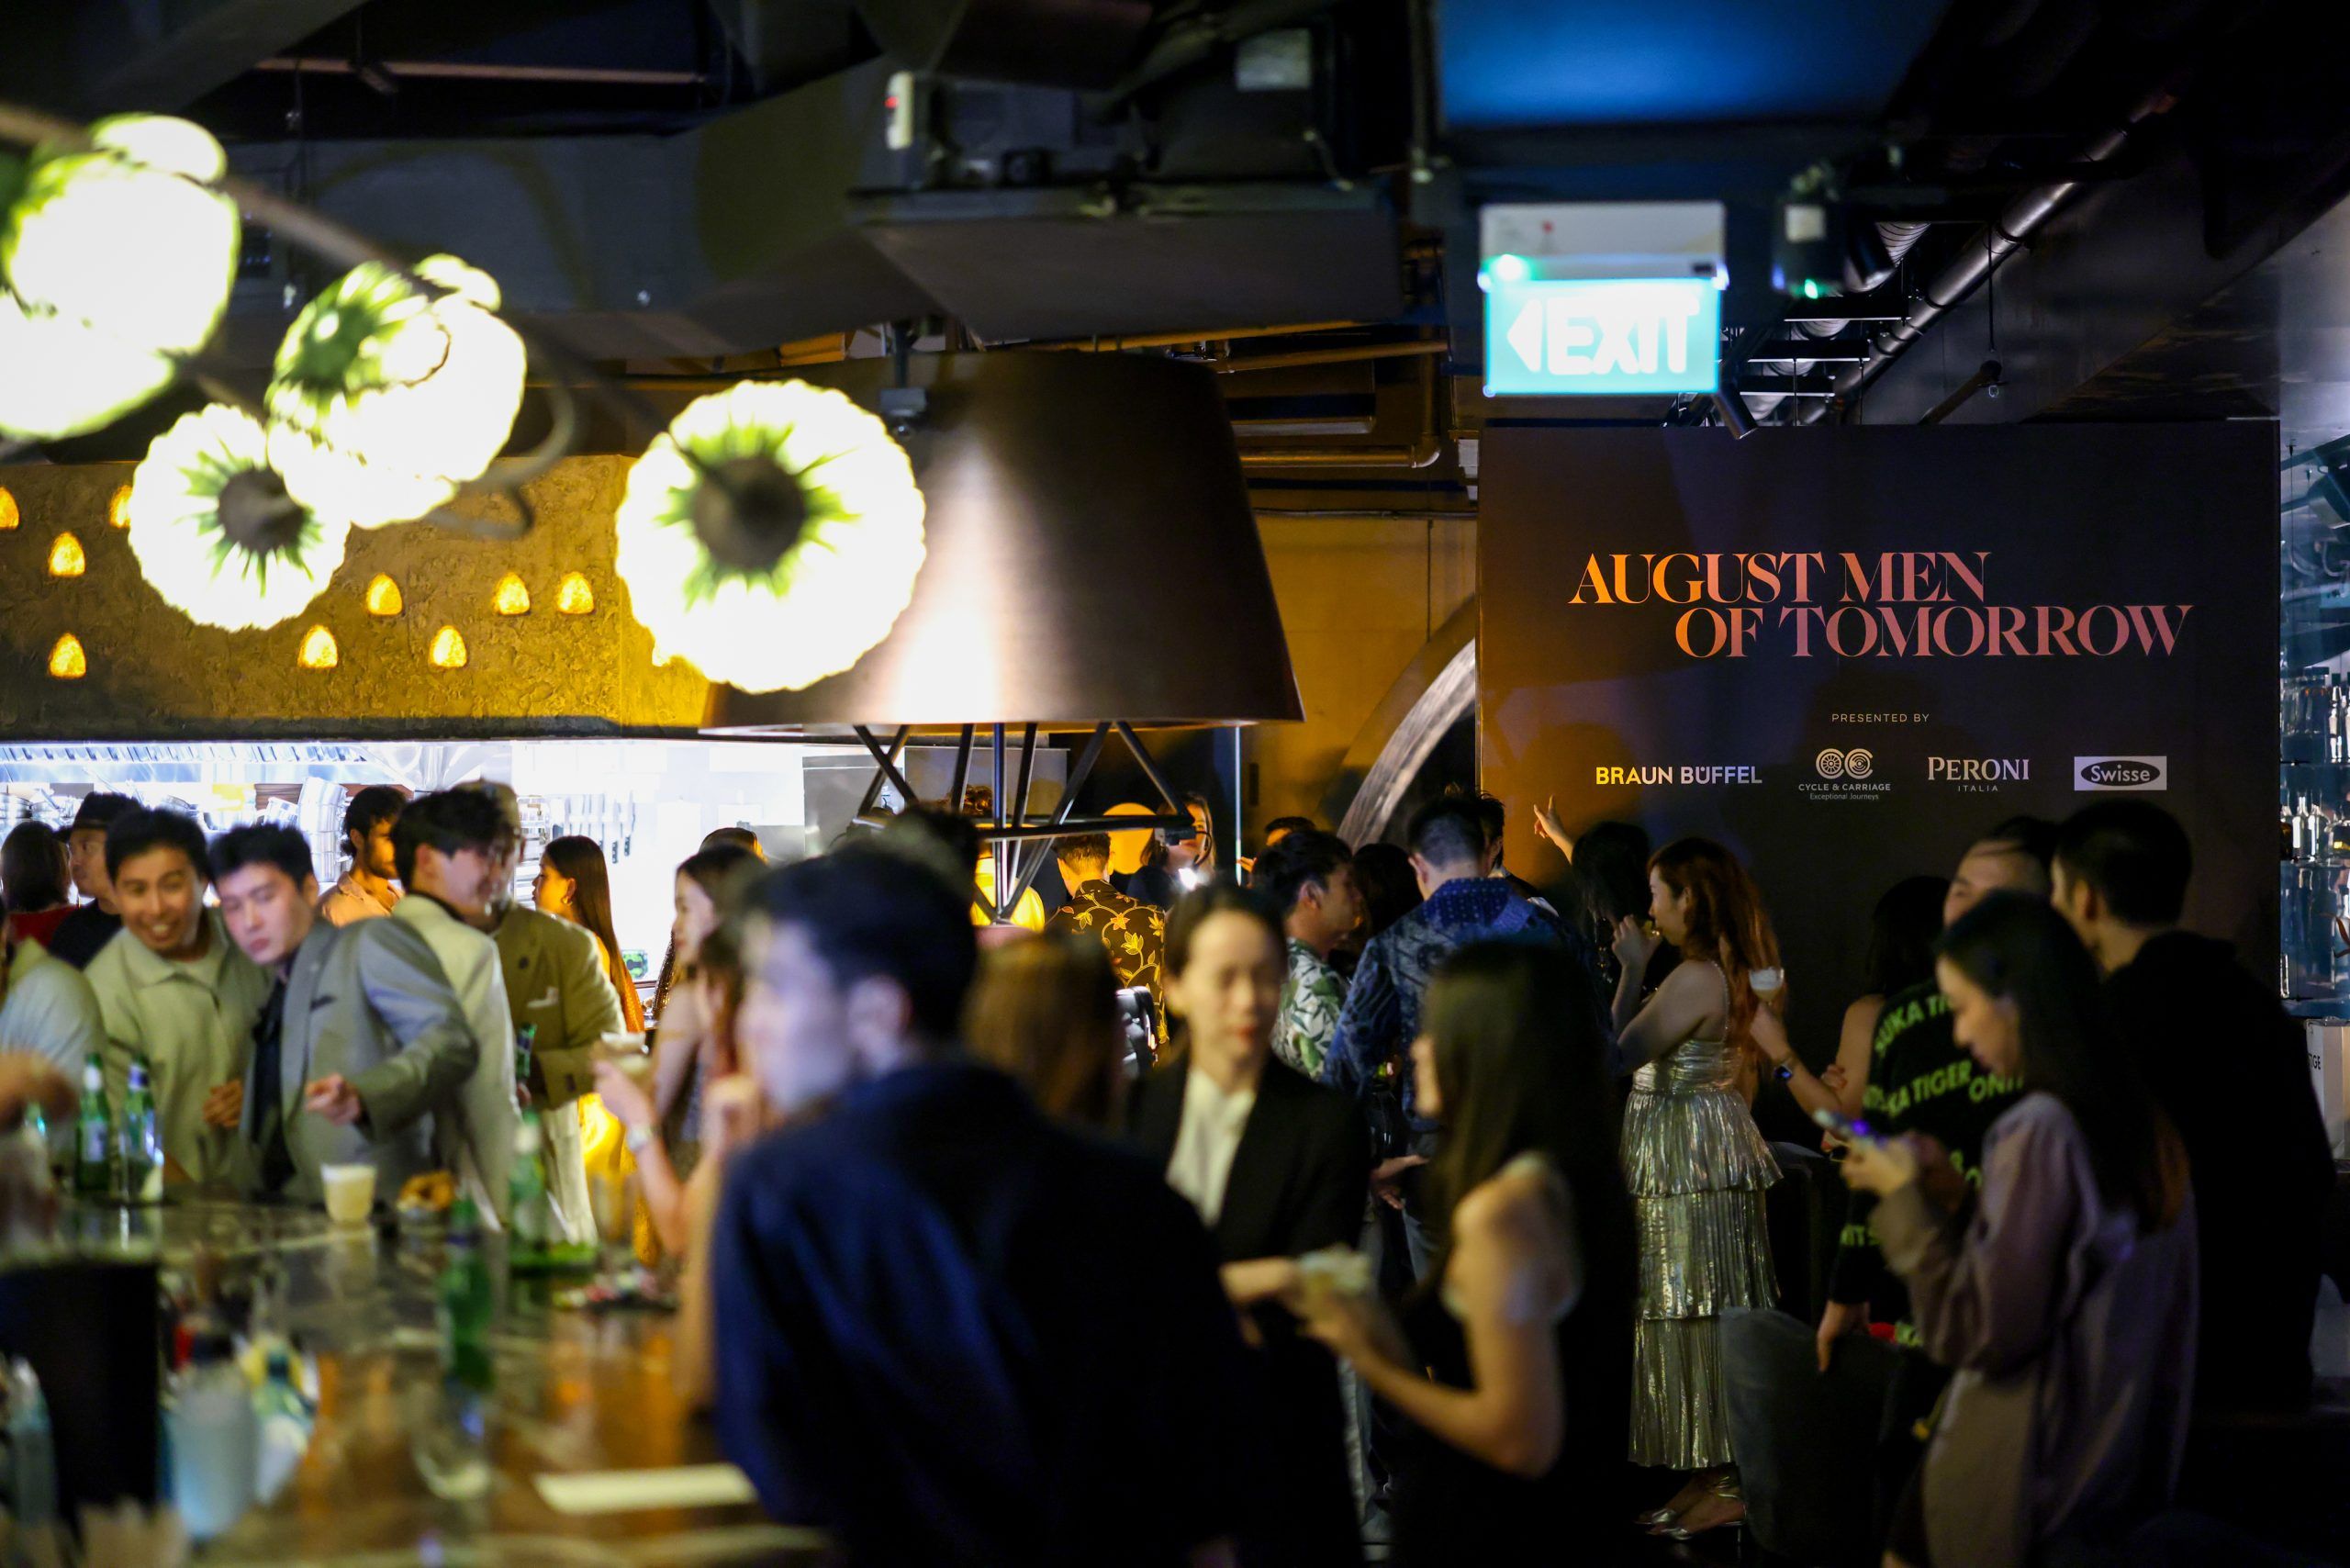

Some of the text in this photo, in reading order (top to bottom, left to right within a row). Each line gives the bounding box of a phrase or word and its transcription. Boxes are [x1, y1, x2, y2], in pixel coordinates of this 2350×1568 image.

[1547, 295, 1700, 375] EXIT
[1568, 551, 1991, 603] AUGUST MEN
[1674, 605, 2194, 657] OF TOMORROW
[1831, 713, 1930, 722] PRESENTED BY
[1595, 765, 1762, 786] BRAUN BÜFFEL
[1928, 756, 2030, 780] PERONI
[2090, 764, 2151, 782] Swisse
[1798, 783, 1891, 791] CYCLE & CARRIAGE
[1809, 793, 1879, 801] Exceptional Journeys
